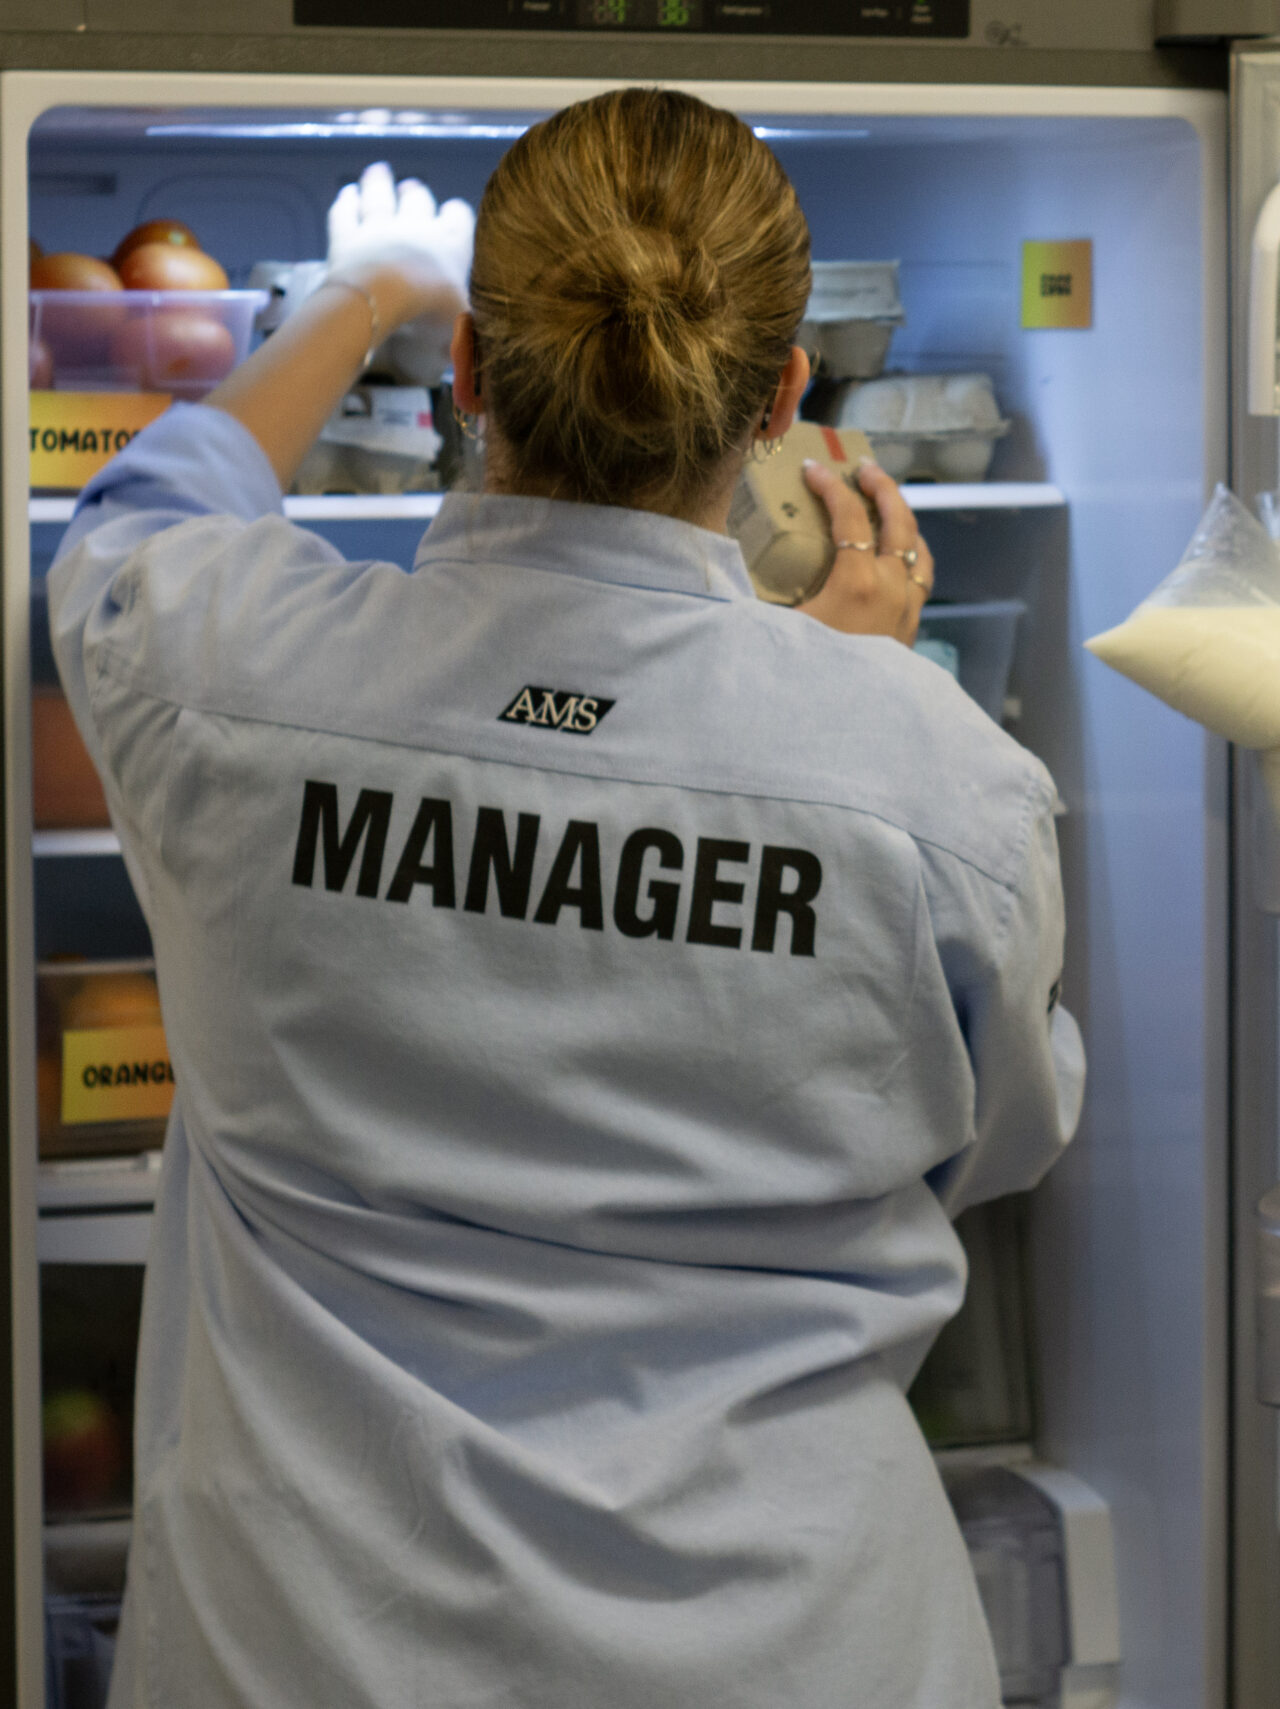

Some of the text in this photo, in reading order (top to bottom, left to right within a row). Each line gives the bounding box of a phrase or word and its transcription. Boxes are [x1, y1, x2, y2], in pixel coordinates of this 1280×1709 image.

[29, 428, 140, 452] TOMATO
[505, 687, 599, 732] AMS
[291, 779, 823, 958] MANAGER
